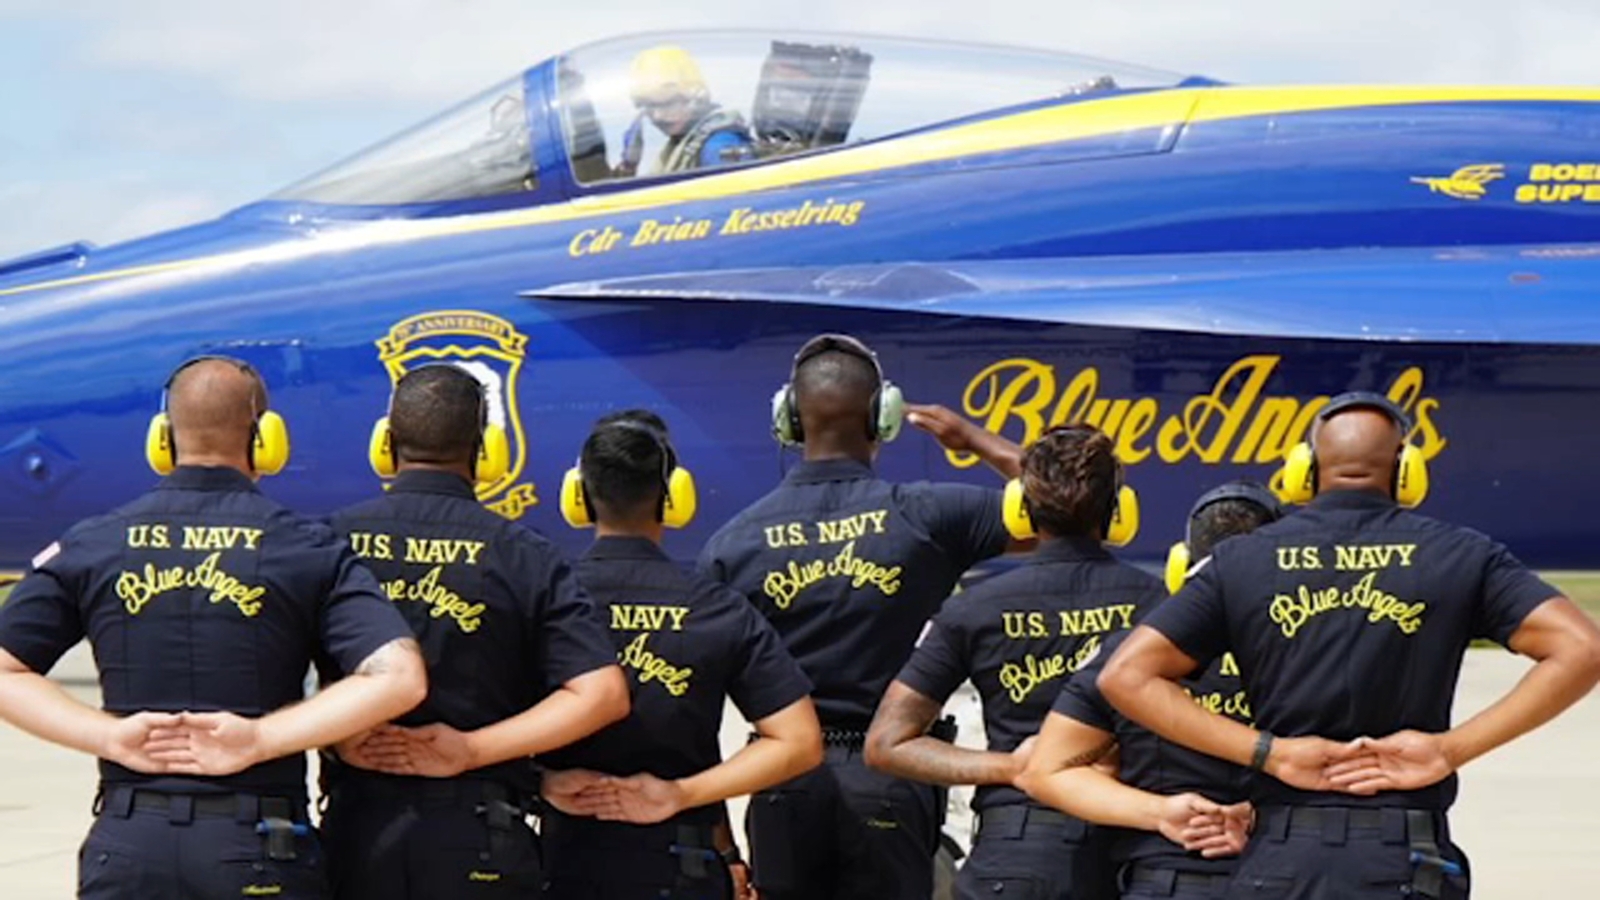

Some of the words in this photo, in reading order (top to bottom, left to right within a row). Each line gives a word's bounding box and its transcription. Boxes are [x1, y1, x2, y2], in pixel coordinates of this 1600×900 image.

[569, 226, 623, 257] Cdr
[629, 216, 711, 247] Brian
[719, 197, 864, 234] Kesselring
[127, 524, 171, 549] U.S.
[181, 526, 264, 550] NAVY
[403, 537, 485, 564] NAVY
[764, 522, 808, 548] U.S.
[816, 509, 887, 543] NAVY
[763, 559, 826, 609] Blue
[826, 540, 902, 595] Angels
[1276, 546, 1323, 571] U.S.
[1334, 543, 1417, 571] NAVY
[115, 562, 185, 615] Blue
[185, 551, 267, 617] Angels
[407, 564, 487, 633] Angels
[1269, 585, 1339, 638] Blue
[1340, 571, 1426, 634] Angels
[609, 604, 690, 631] NAVY
[1001, 611, 1049, 638] U.S.
[1058, 603, 1136, 636] NAVY
[616, 632, 692, 696] Angels
[999, 654, 1066, 703] Blue
